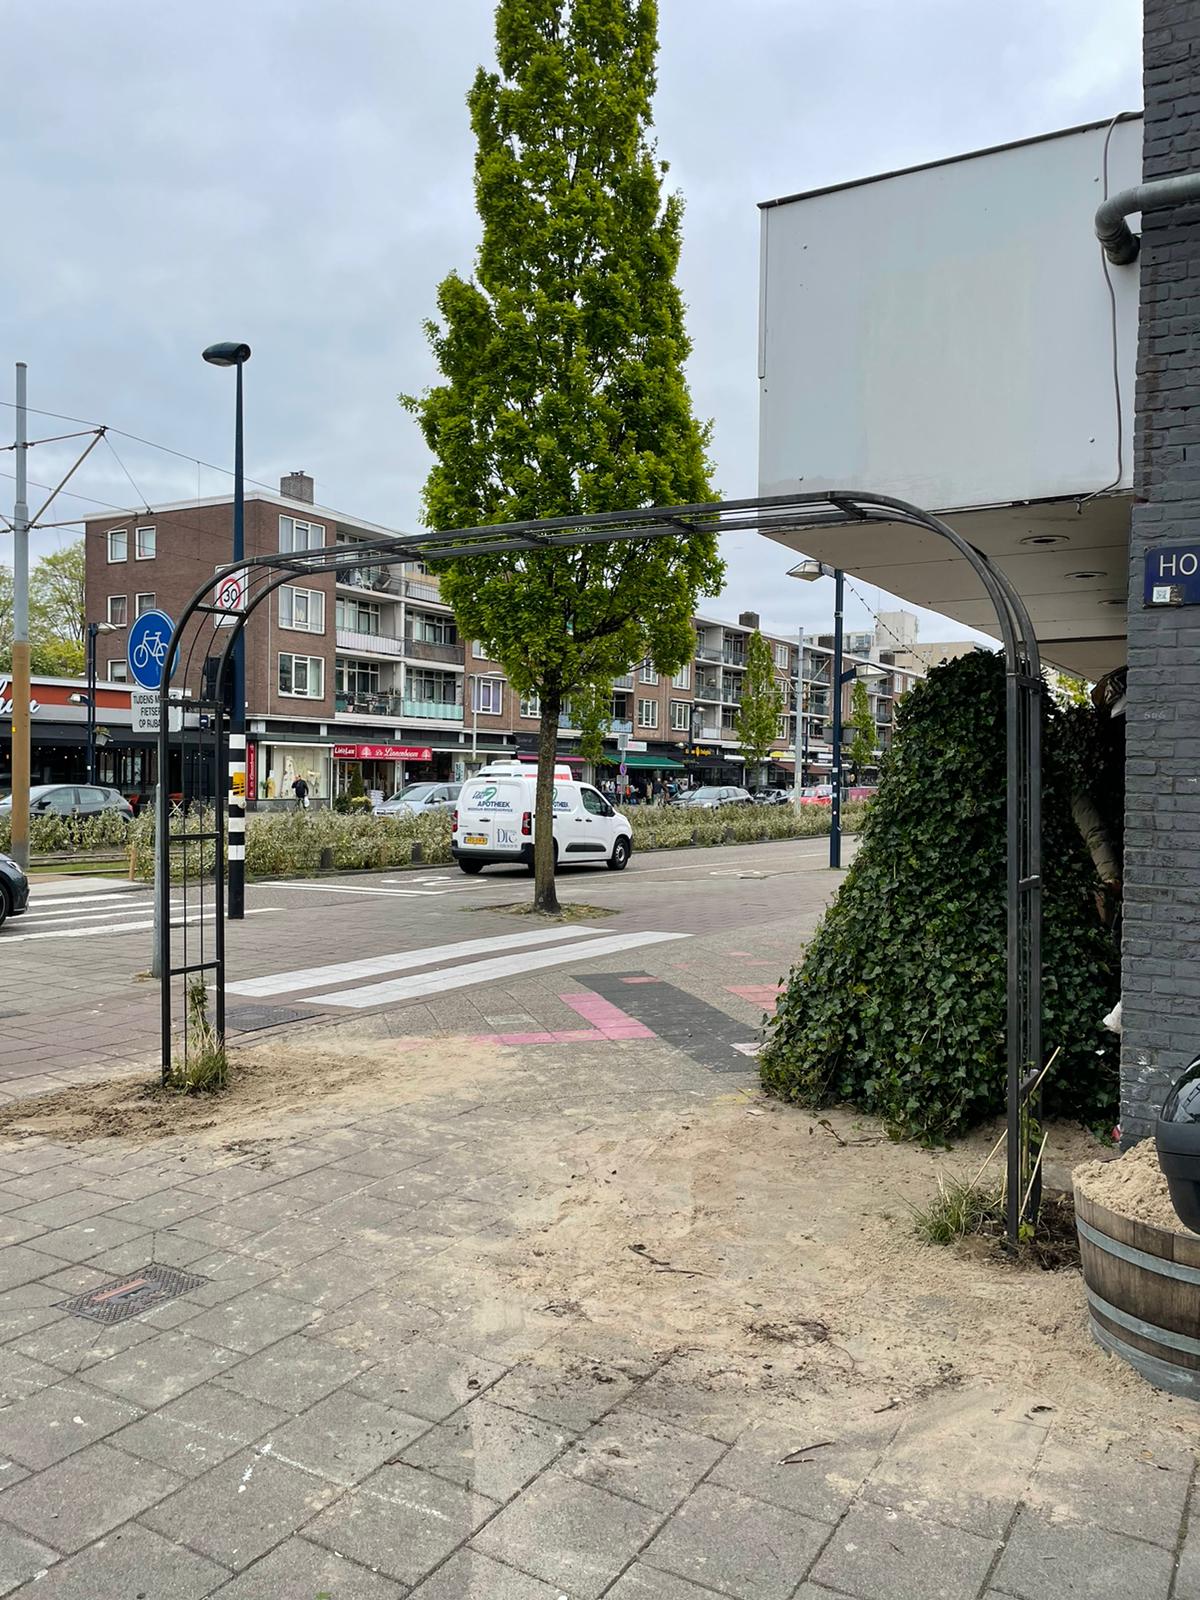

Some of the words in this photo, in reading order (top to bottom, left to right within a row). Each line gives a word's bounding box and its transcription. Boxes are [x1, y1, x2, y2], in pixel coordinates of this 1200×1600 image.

[1160, 553, 1198, 577] HO
[223, 588, 238, 602] 30
[138, 719, 146, 728] OP
